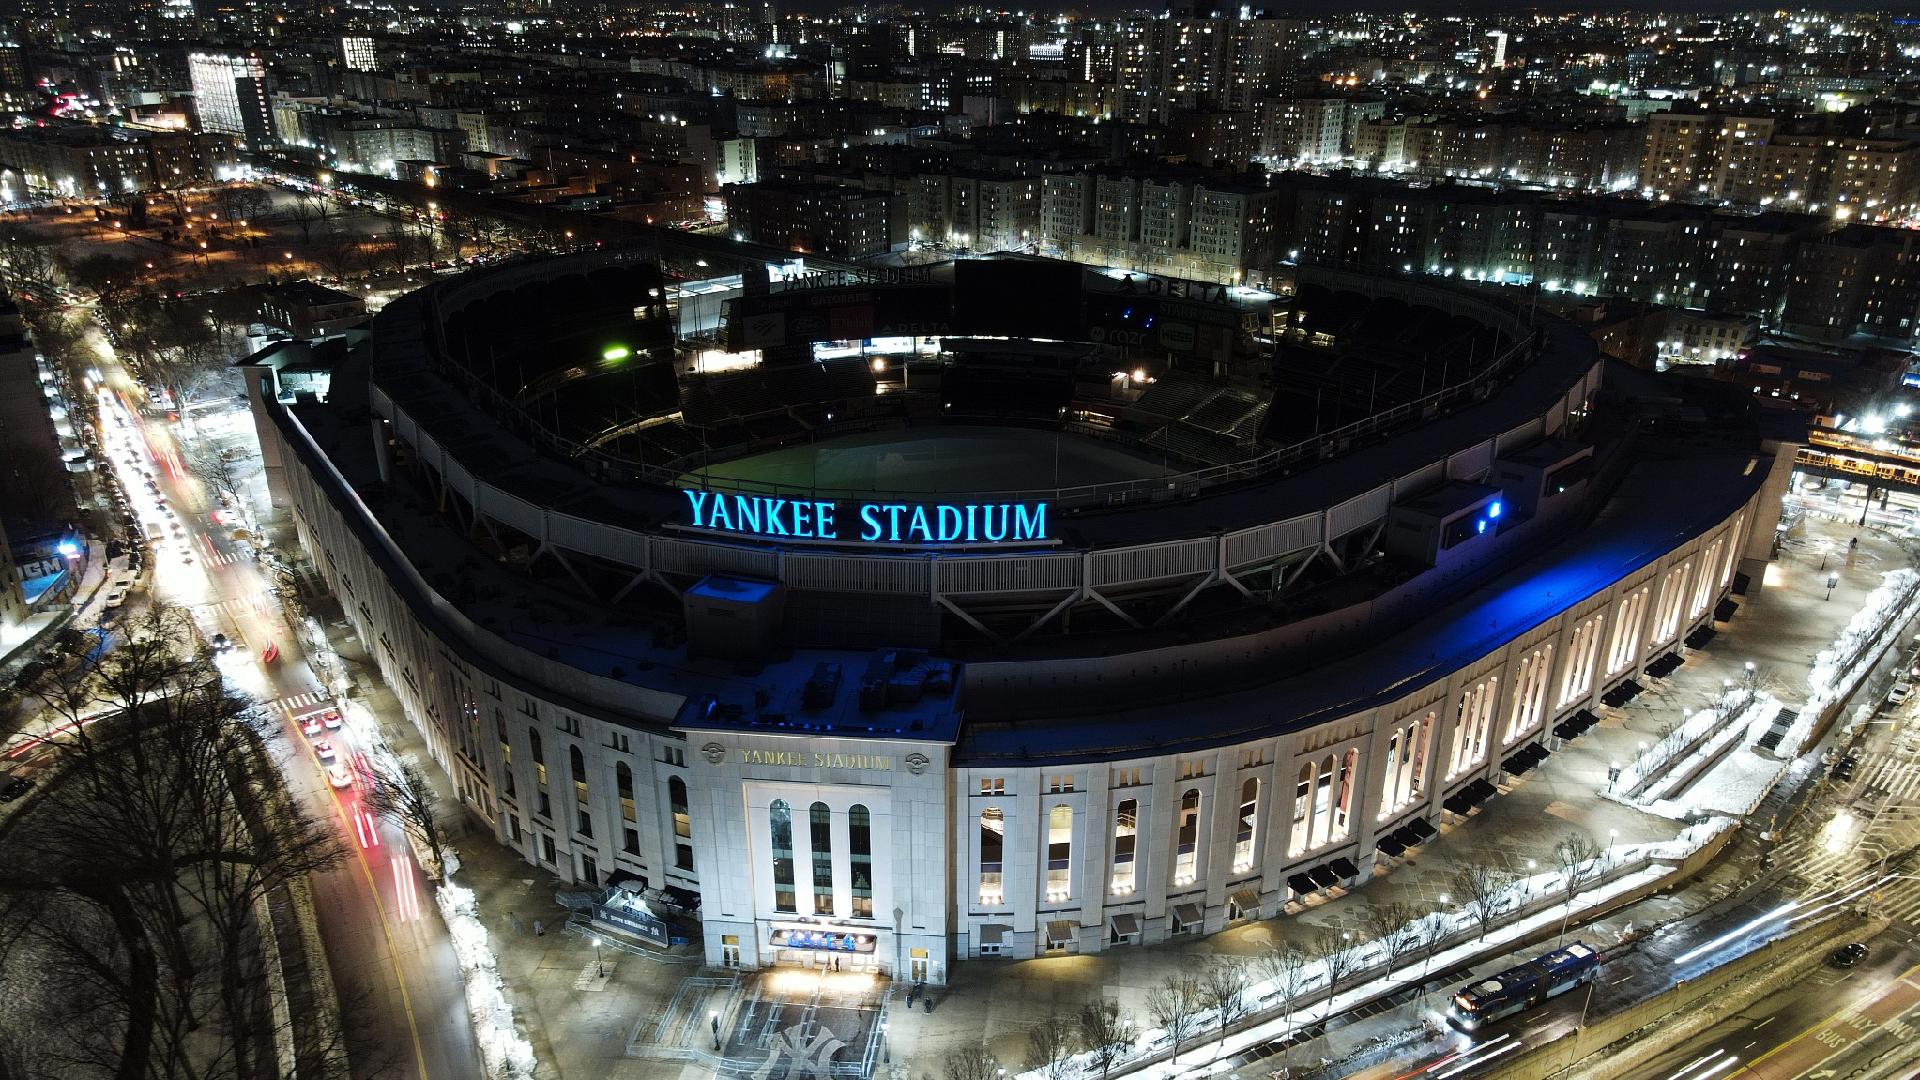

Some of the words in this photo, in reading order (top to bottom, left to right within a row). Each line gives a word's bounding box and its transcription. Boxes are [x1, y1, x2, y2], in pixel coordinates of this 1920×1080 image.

[783, 270, 847, 290] YANKEE
[856, 267, 931, 286] STADIUM
[1148, 277, 1228, 305] DELTA
[897, 322, 951, 333] DELTA
[683, 490, 837, 539] YANKEE
[860, 503, 1048, 541] STADIUM
[741, 750, 806, 765] YANKEE
[814, 753, 892, 770] STADIUM
[788, 930, 838, 949] GATE
[842, 933, 856, 951] 4
[1815, 1027, 1847, 1049] BUS
